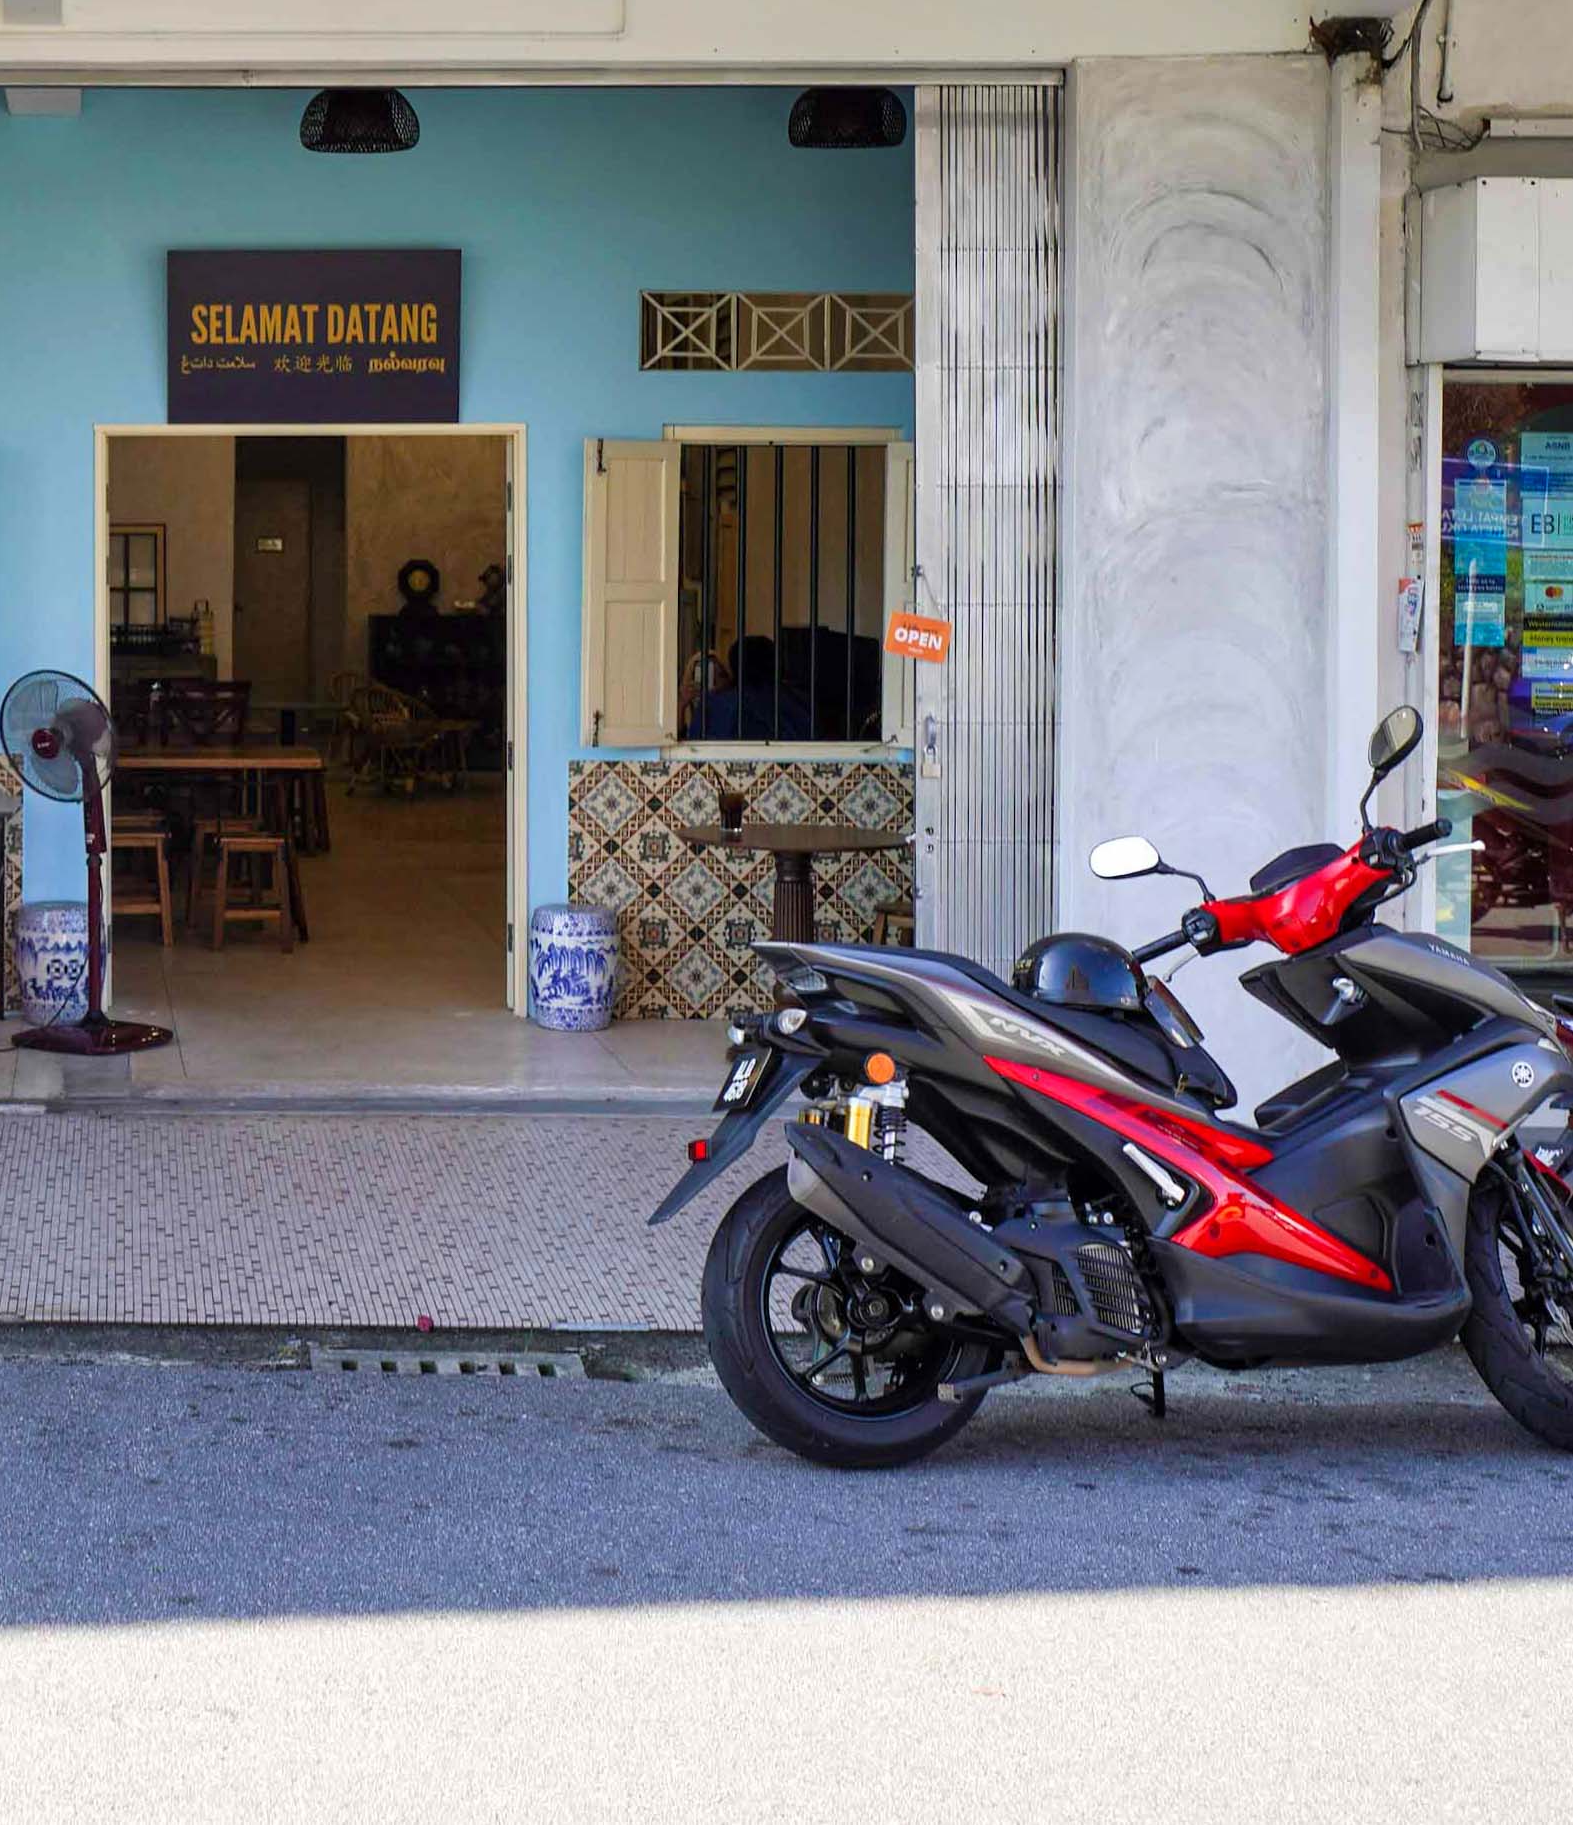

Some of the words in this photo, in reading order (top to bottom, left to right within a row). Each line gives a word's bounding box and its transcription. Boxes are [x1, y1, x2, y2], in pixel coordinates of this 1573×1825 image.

[190, 302, 319, 345] SELAMAT
[327, 302, 438, 345] DATANG
[274, 353, 354, 374] 欢迎光临
[894, 627, 943, 651] OPEN
[1427, 942, 1470, 967] YAMAHA
[1412, 1106, 1473, 1142] 155
